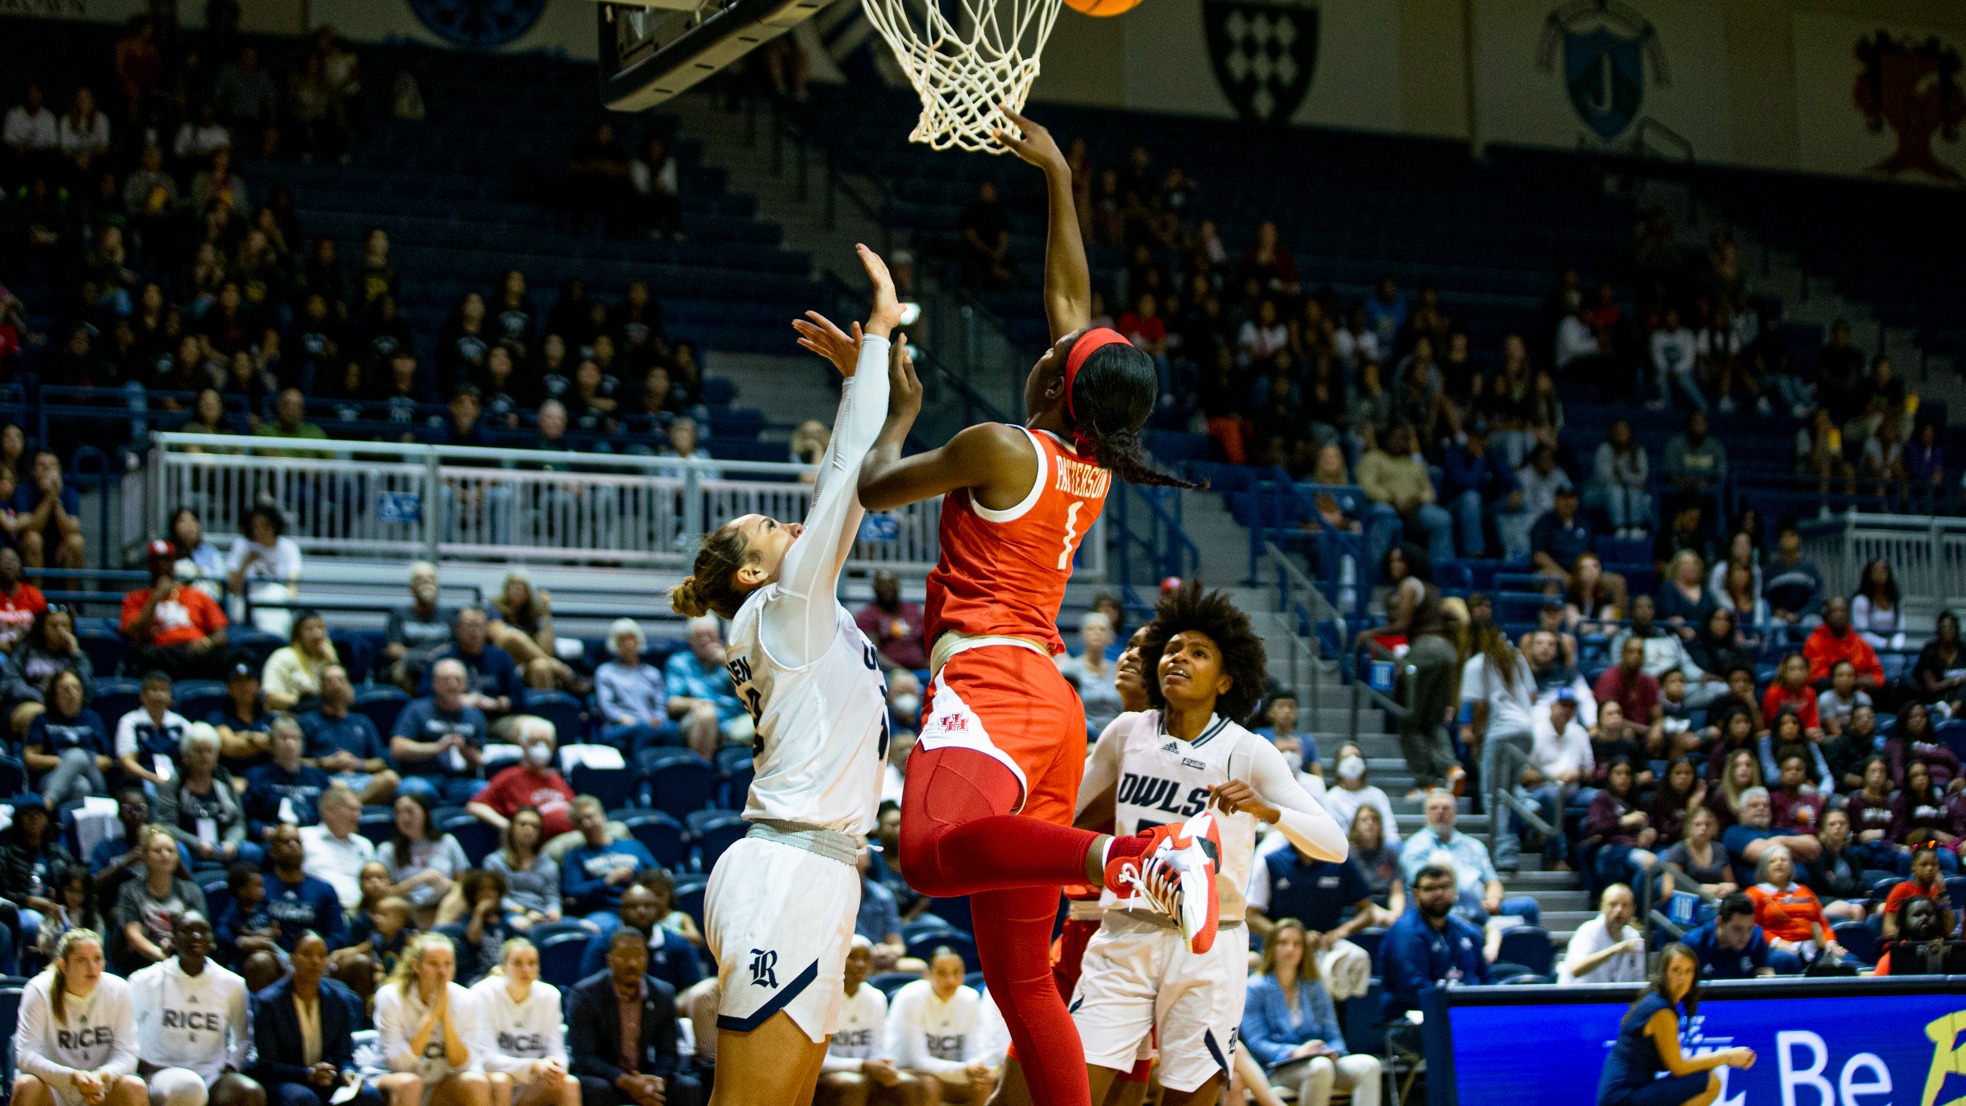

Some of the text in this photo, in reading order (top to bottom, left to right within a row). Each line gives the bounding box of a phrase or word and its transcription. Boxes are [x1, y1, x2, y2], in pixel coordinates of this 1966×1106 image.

[1055, 455, 1108, 498] PATTERSON
[1057, 501, 1084, 570] 1
[1118, 773, 1211, 817] OWLS
[749, 948, 779, 989] R
[58, 1026, 112, 1049] RICE
[163, 1009, 219, 1031] RICE
[1776, 1029, 1892, 1106] Be
